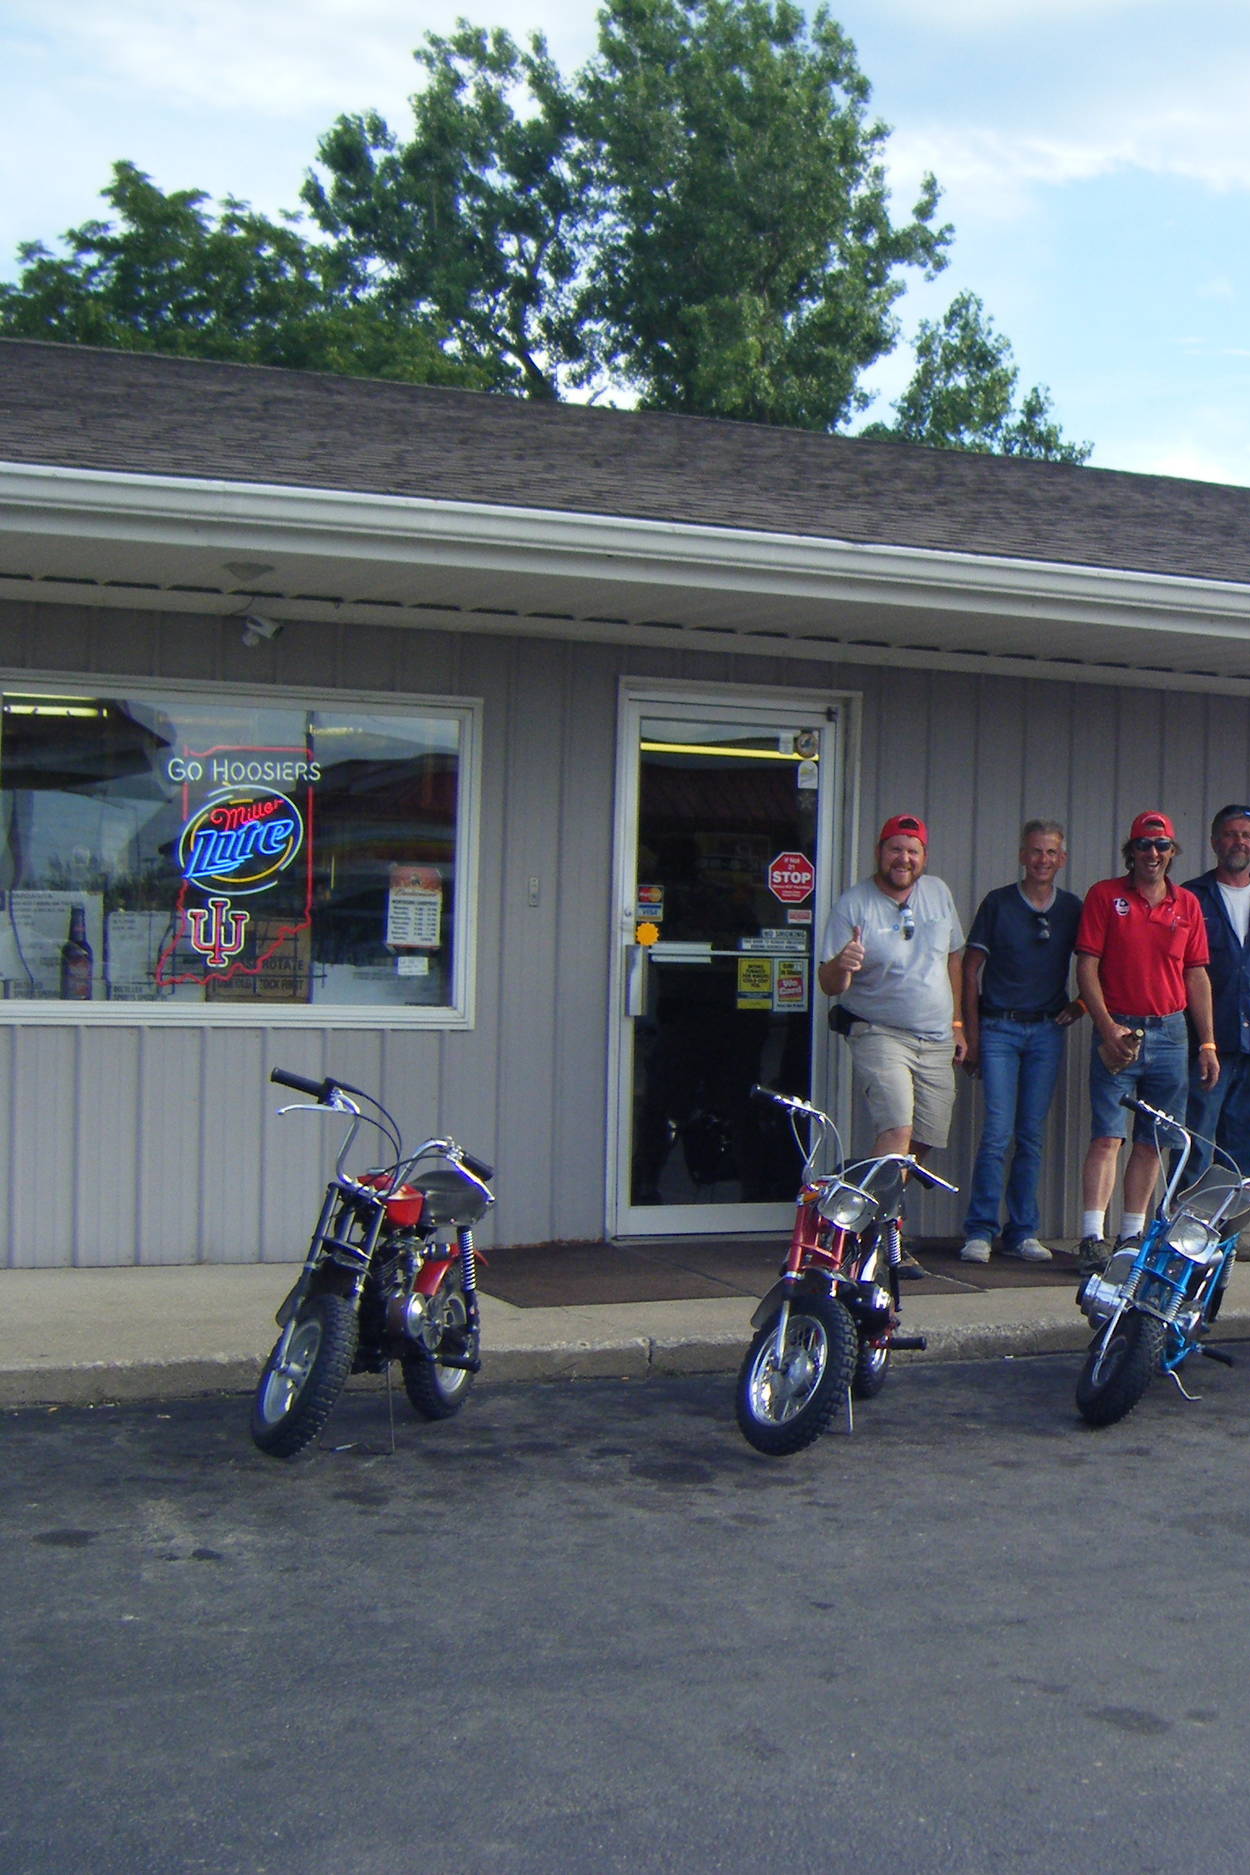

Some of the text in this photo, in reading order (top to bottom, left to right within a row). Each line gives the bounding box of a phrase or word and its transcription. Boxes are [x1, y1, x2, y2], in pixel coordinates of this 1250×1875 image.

[168, 758, 321, 781] GO HOOSIERS
[210, 800, 285, 832] Miller
[183, 819, 294, 879] Lite
[772, 871, 811, 884] STOP
